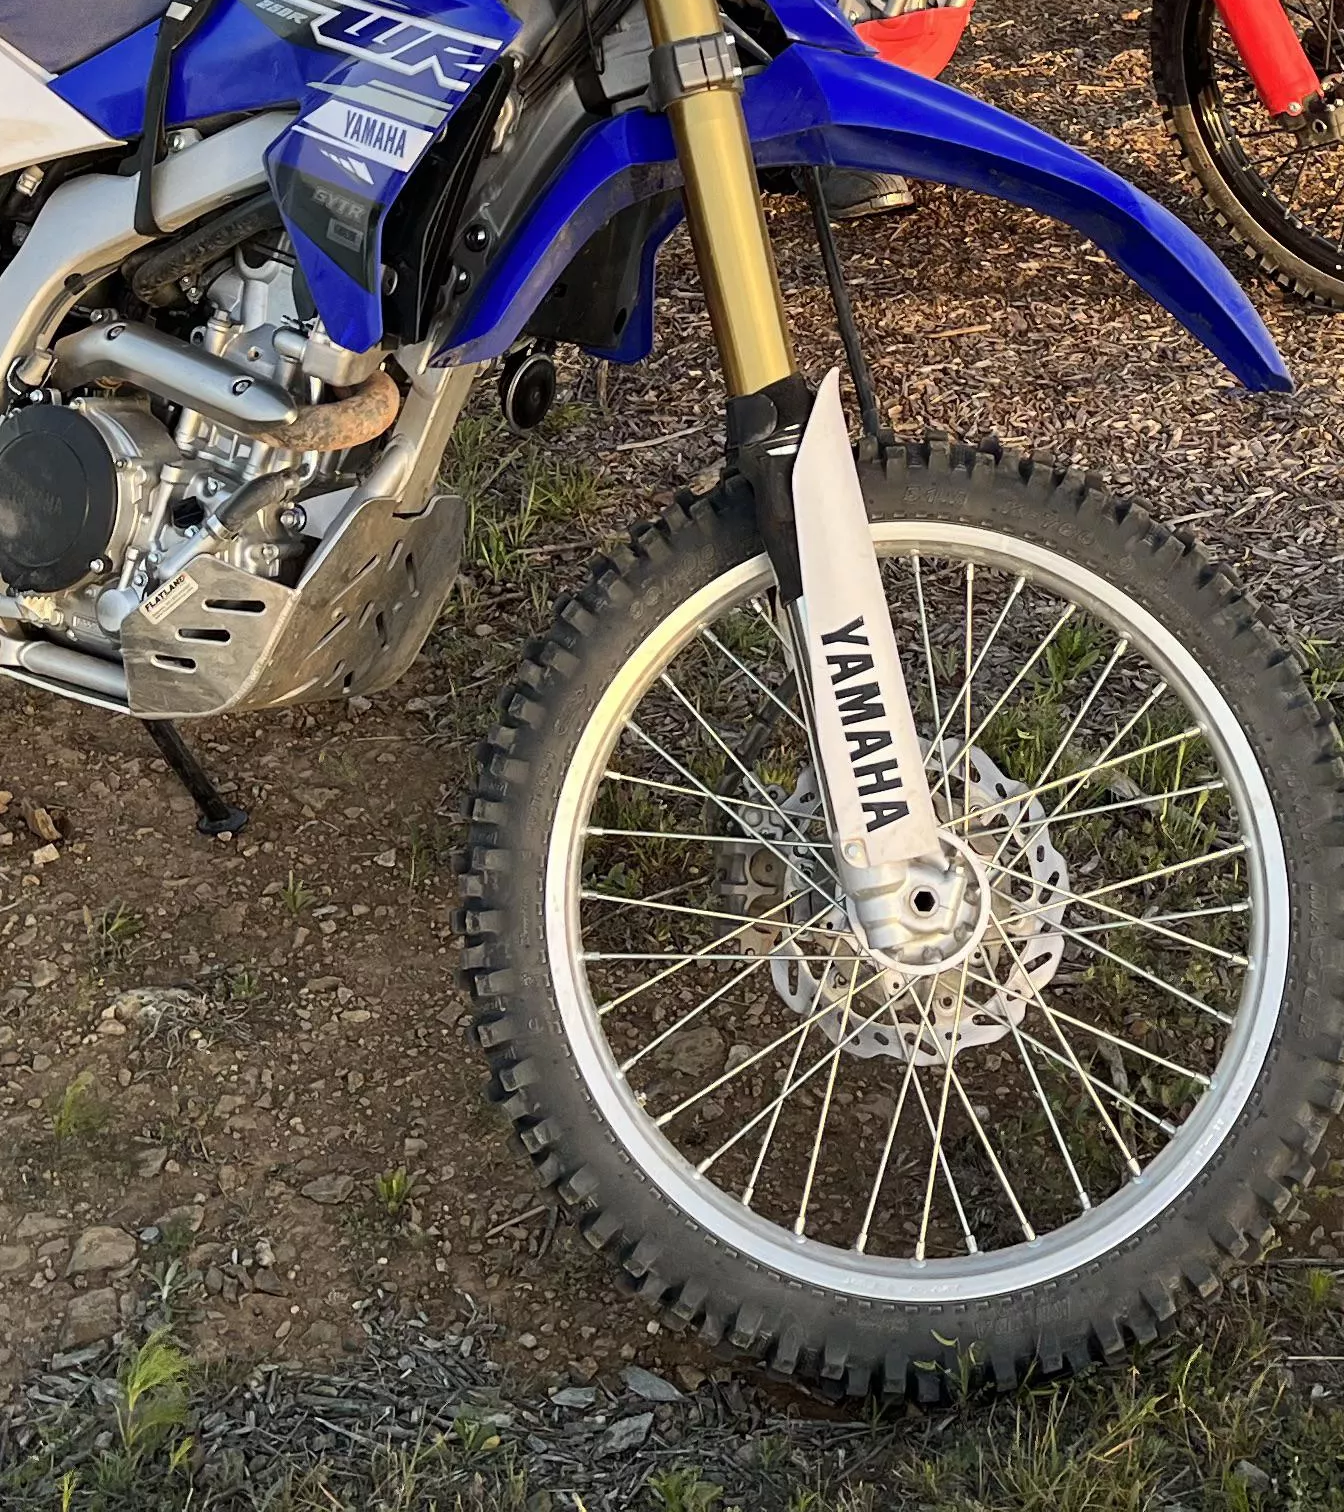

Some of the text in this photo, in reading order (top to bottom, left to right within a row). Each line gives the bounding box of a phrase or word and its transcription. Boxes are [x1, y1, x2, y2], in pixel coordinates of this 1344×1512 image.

[256, 0, 308, 25] 250R
[344, 109, 408, 158] YAMAHA
[145, 574, 186, 612] FLATLAND
[821, 615, 910, 833] YAMAHA
